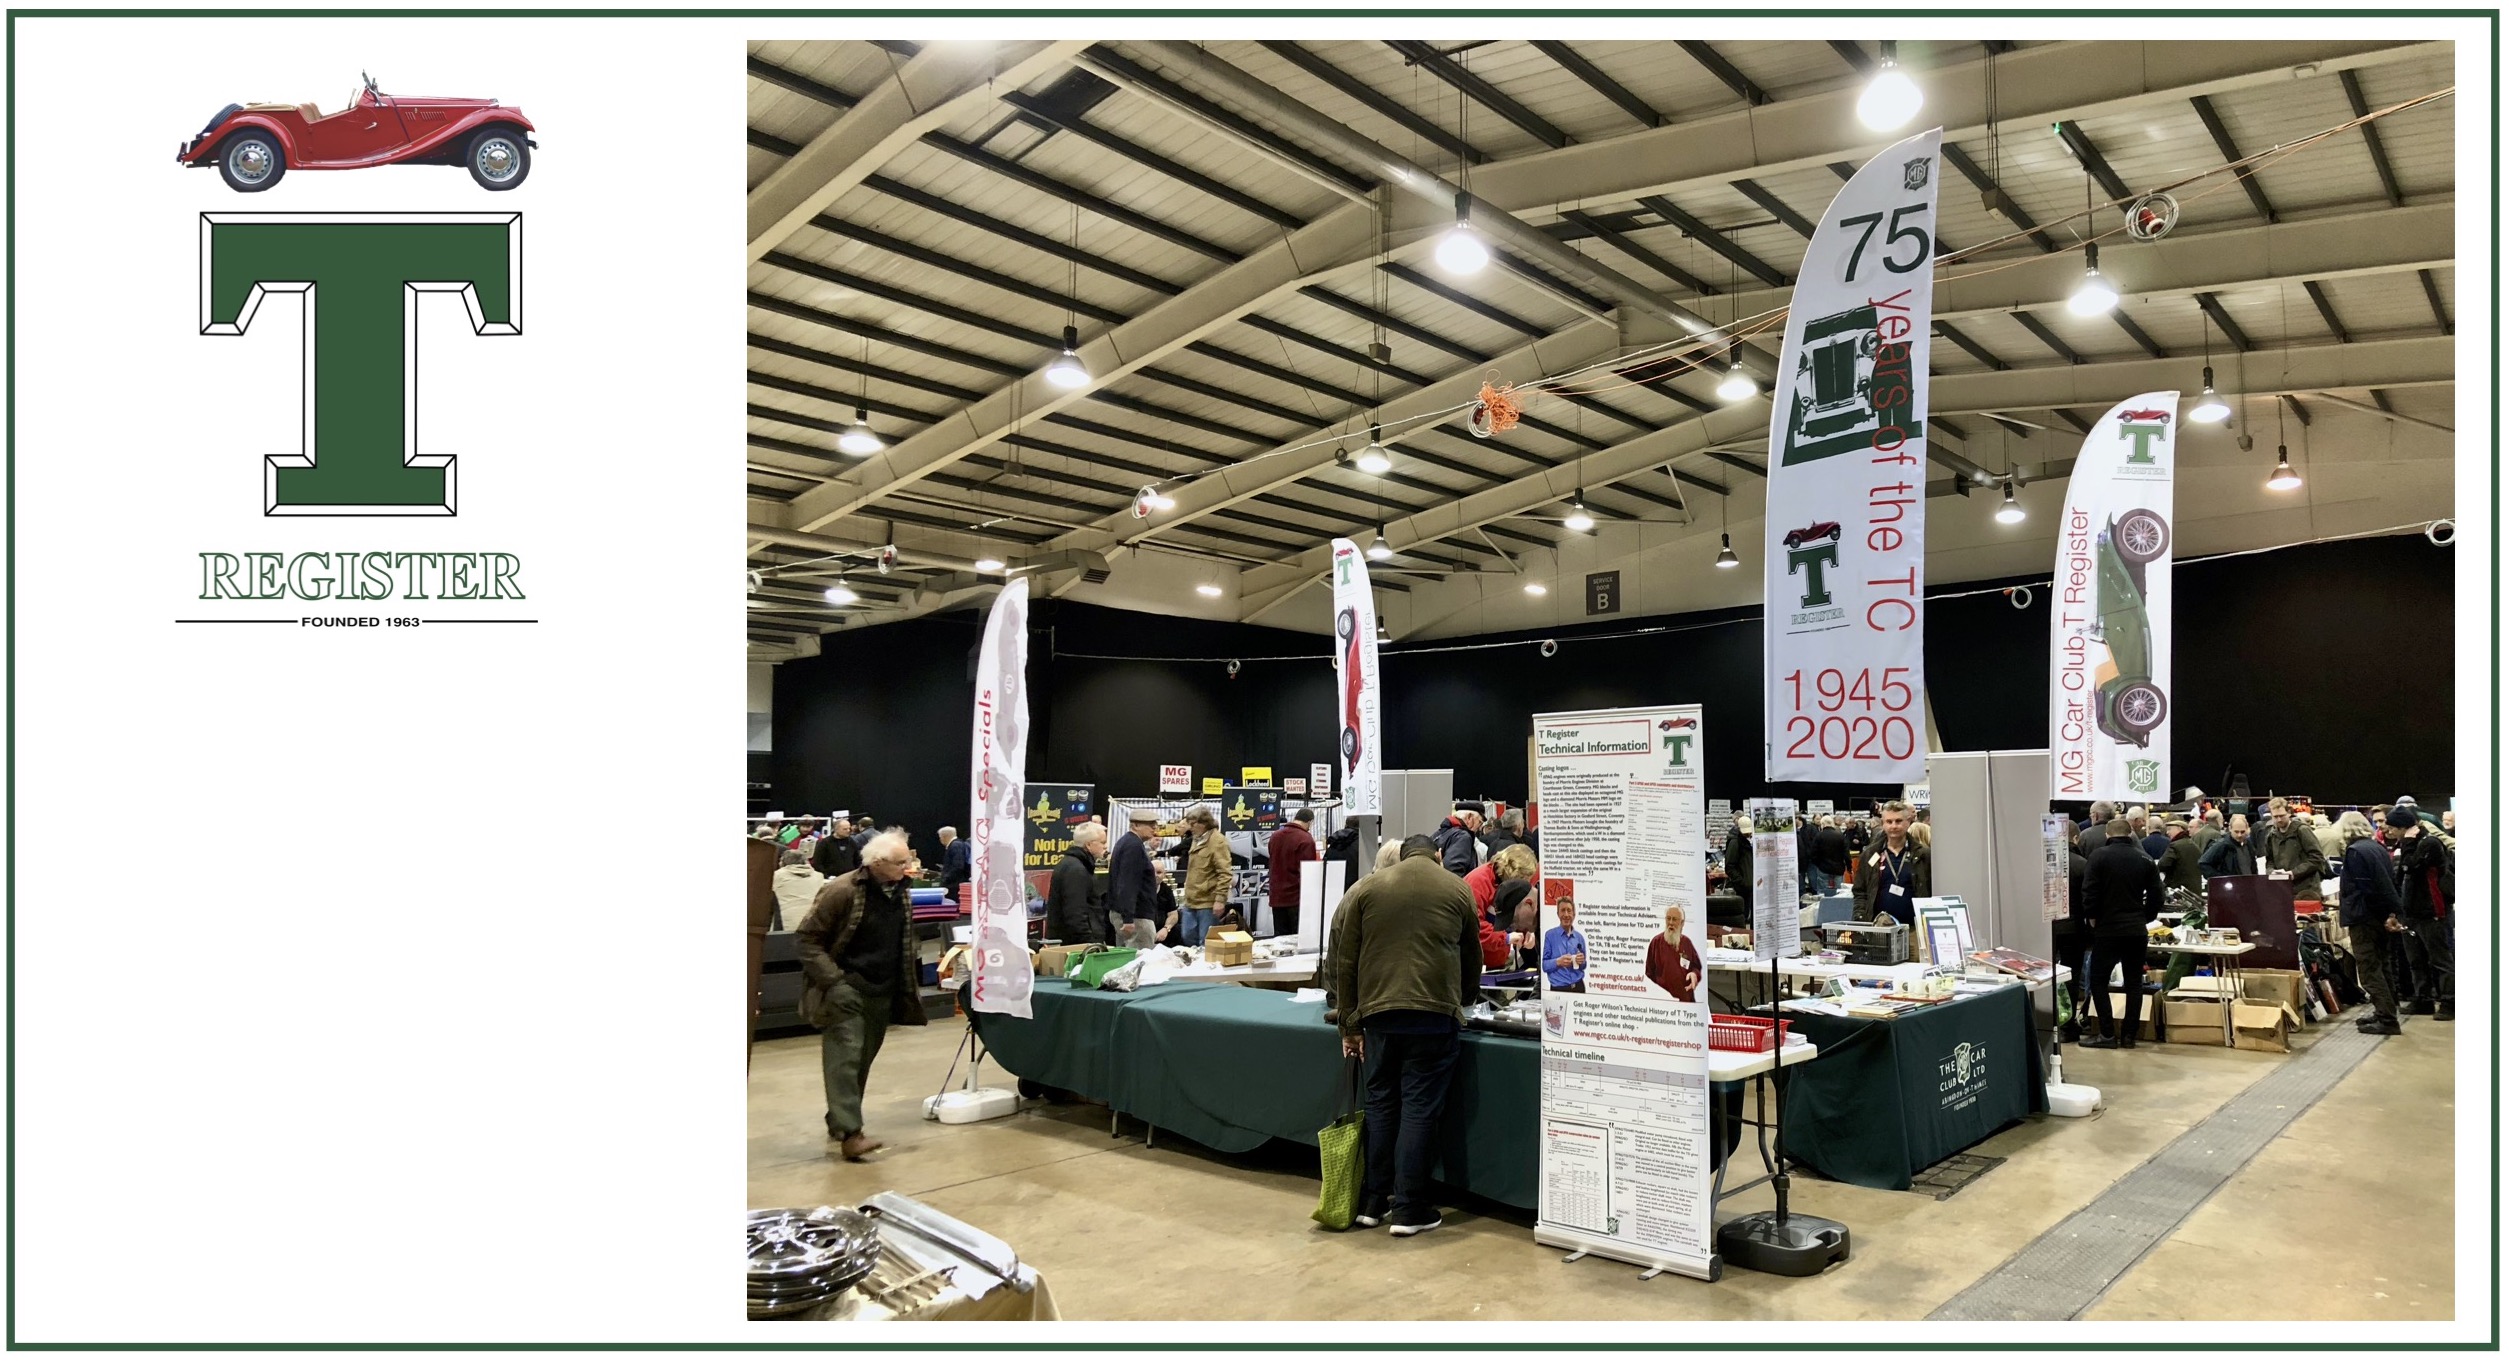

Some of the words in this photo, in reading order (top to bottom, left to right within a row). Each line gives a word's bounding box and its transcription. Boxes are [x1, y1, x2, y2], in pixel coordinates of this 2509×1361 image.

[1840, 202, 1930, 283] 75
[1868, 289, 1912, 409] years
[1871, 425, 1917, 465] of
[2119, 423, 2166, 464] T
[1867, 481, 1917, 551] the
[2064, 507, 2092, 604] Register
[1787, 542, 1839, 609] T
[1598, 593, 1609, 610] B
[1866, 566, 1917, 632] TC
[1791, 608, 1845, 625] REGISTER
[2063, 612, 2085, 629] T
[2062, 637, 2085, 691] Club
[1784, 667, 1912, 712] 1945
[2061, 699, 2084, 742] Car
[977, 688, 993, 802] Specials
[1539, 730, 1544, 738] T
[1547, 729, 1579, 740] Register
[1539, 743, 1584, 755] Technical
[1588, 741, 1648, 753] Information
[1786, 715, 1915, 761] 2020
[1663, 734, 1693, 767] T
[1162, 777, 1190, 785] SPARES
[1165, 767, 1187, 776] MG
[2060, 751, 2084, 793] MG
[1034, 838, 1056, 852] Not
[1024, 853, 1042, 866] for
[1589, 973, 1644, 982] www.mgcc.co.uk/
[1589, 982, 1647, 992] t-register/contacts
[1573, 1010, 1592, 1018] engines
[1621, 1013, 1643, 1021] technical
[1645, 1016, 1677, 1026] publications
[1678, 1019, 1692, 1027] from
[1579, 1018, 1603, 1027] Register's
[1585, 1001, 1600, 1010] Roger
[1601, 1003, 1623, 1011] Wilson's
[1624, 1005, 1647, 1014] Technical
[1649, 1008, 1669, 1017] History
[1670, 1008, 1677, 1016] of
[1683, 1010, 1698, 1018] Type
[1542, 1045, 1573, 1058] Technical
[1575, 1050, 1605, 1062] timeline
[1573, 1030, 1702, 1050] www.mgcc.co.uk/t-register/tregistershop
[1939, 1061, 1956, 1076] THE
[1971, 1048, 1986, 1063] CAR
[1940, 1077, 1957, 1092] CLUB
[1973, 1065, 1986, 1077] LTD
